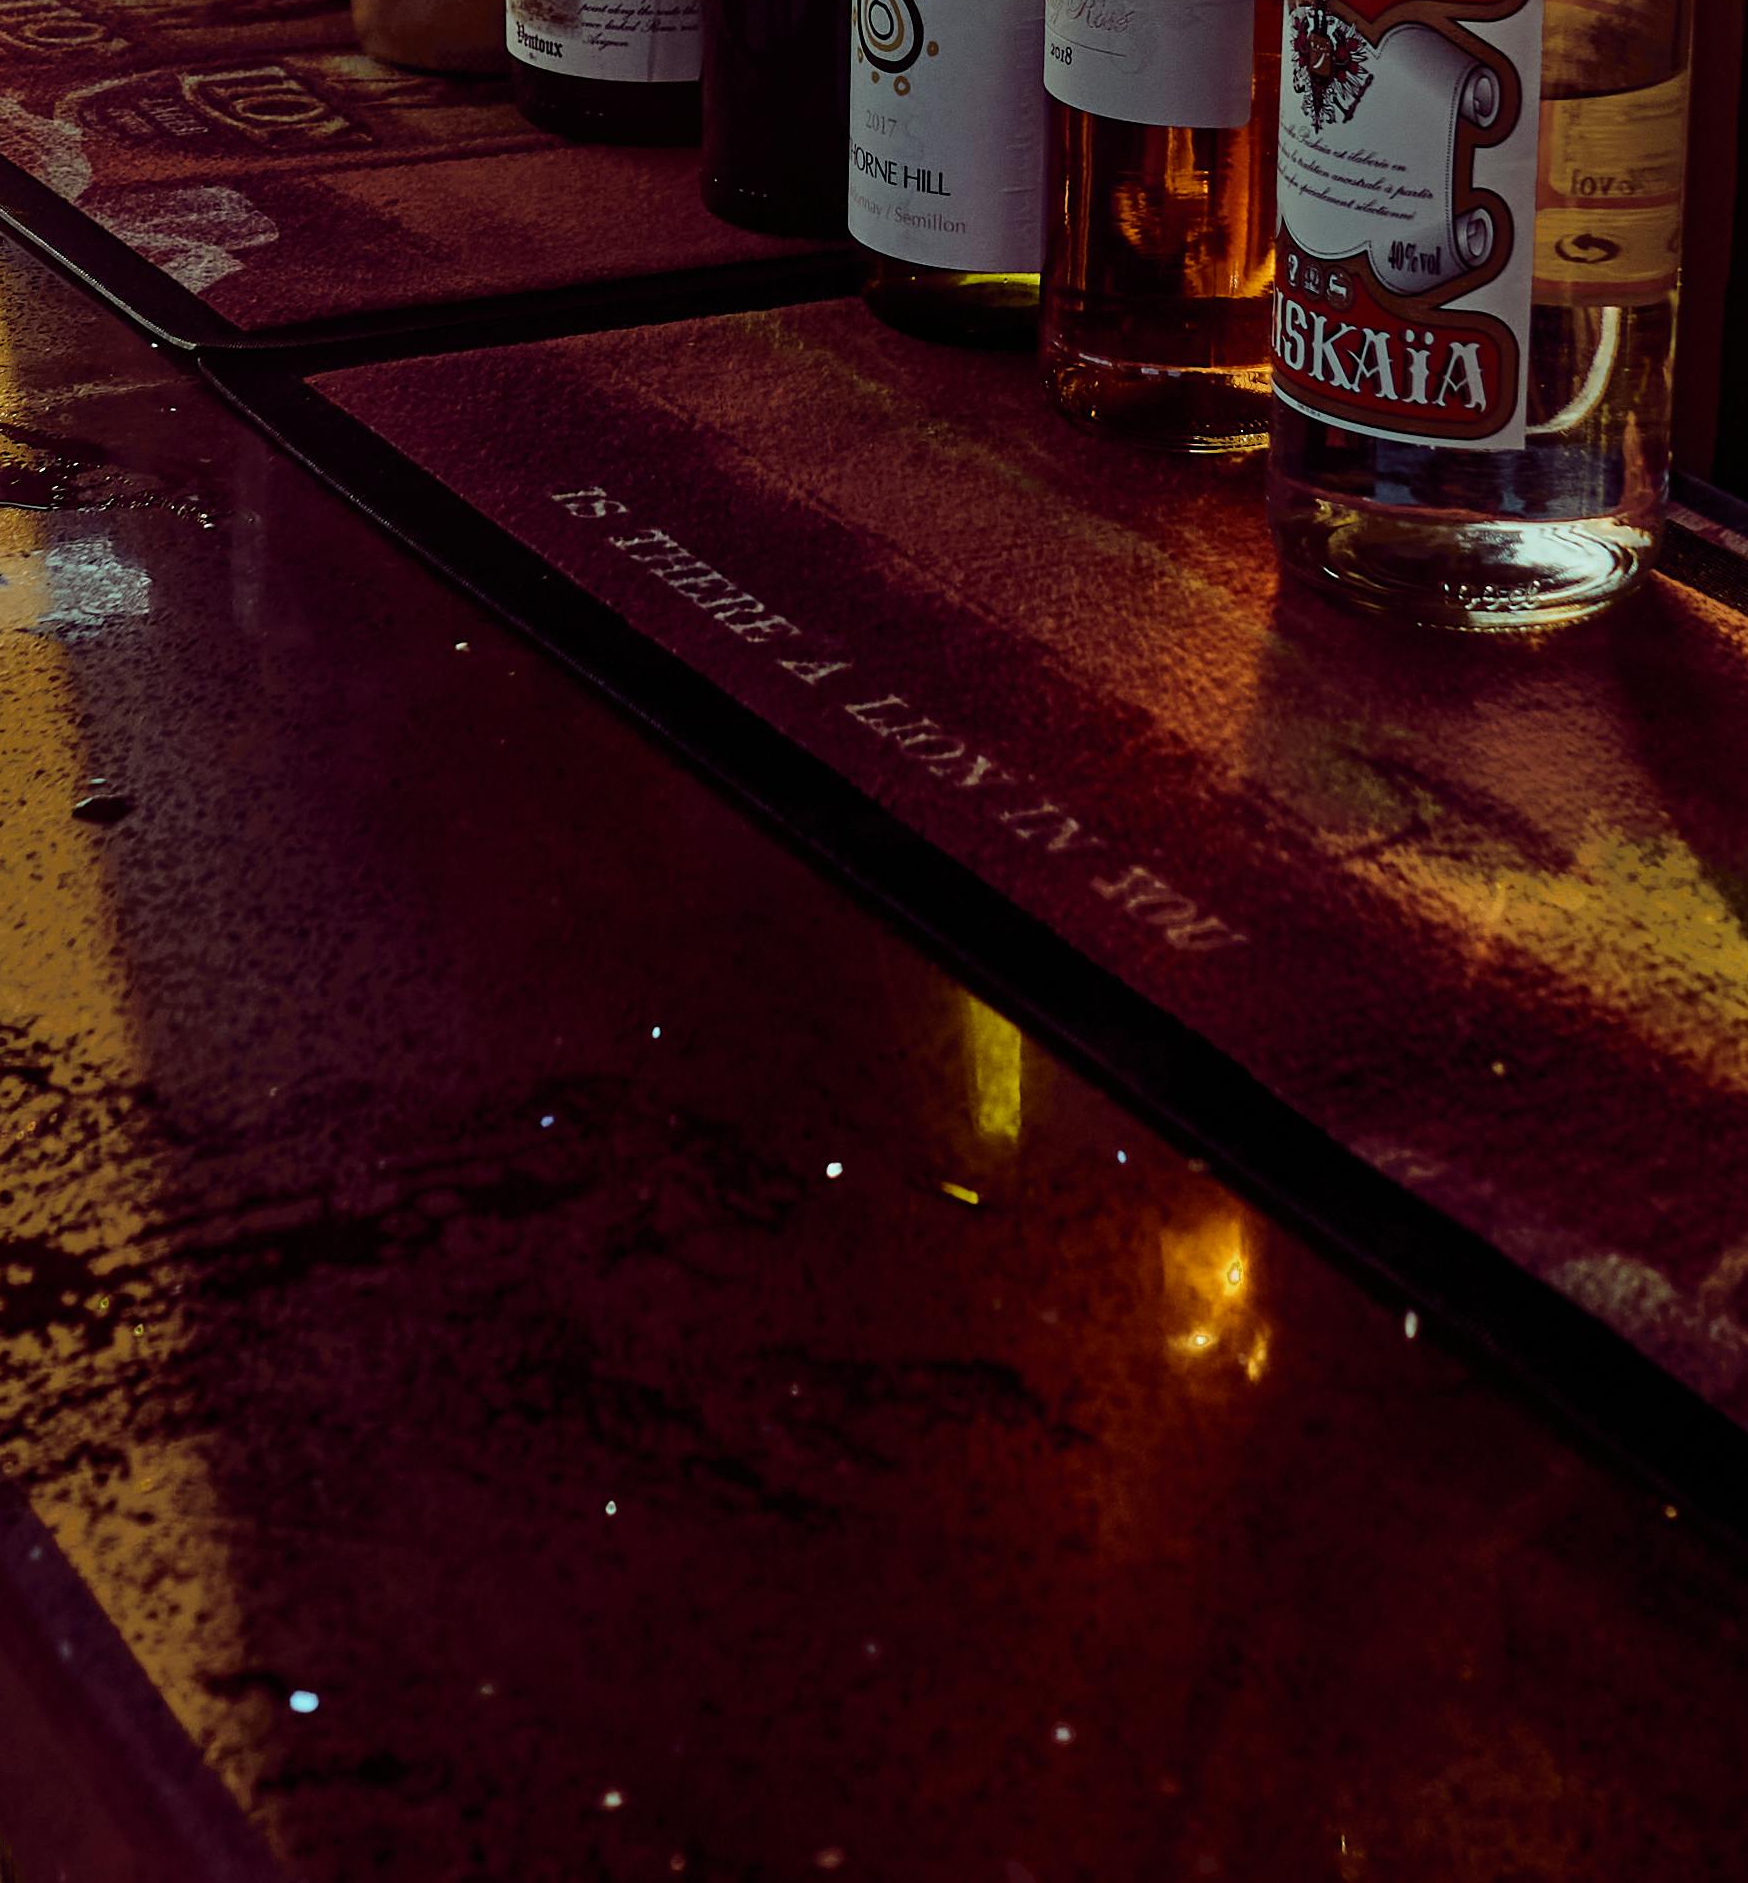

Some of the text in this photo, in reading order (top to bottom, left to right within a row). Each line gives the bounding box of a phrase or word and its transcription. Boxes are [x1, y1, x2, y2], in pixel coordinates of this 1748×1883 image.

[517, 20, 564, 59] Ventoux
[1050, 42, 1073, 66] 2018
[865, 110, 899, 139] 2017
[903, 165, 952, 197] HILL
[894, 207, 967, 234] Semillon
[550, 483, 628, 521] IS
[609, 525, 803, 648] THERE
